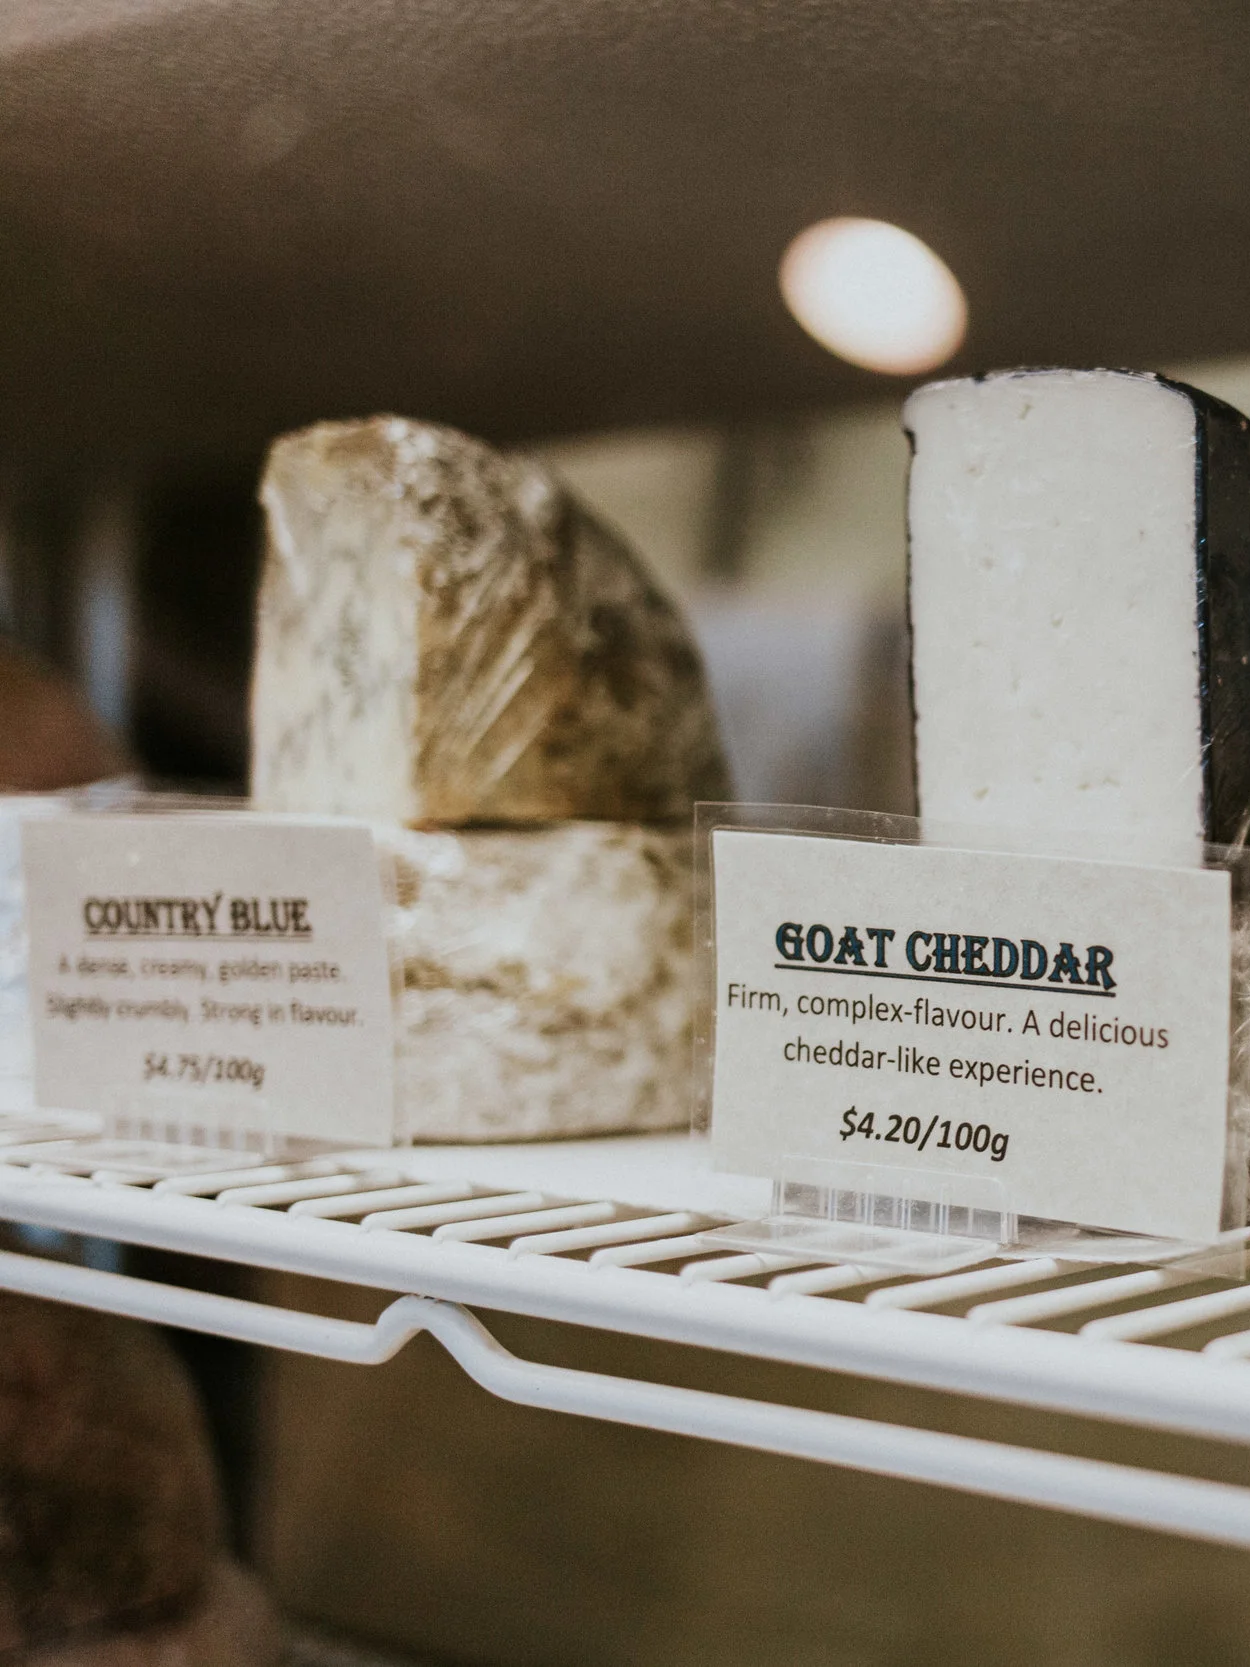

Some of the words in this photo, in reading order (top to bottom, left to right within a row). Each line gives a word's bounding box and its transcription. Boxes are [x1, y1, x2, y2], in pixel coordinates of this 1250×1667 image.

[83, 889, 223, 934] COUNTRY
[230, 895, 313, 935] BLUE
[218, 956, 284, 986] golden
[775, 922, 895, 968] GOAT
[906, 930, 1117, 990] CHEDDAR
[268, 1000, 286, 1023] in
[727, 983, 789, 1017] Firm,
[796, 990, 1013, 1036] complex-flavour.
[1022, 1009, 1041, 1036] A
[1049, 1011, 1170, 1050] delicious
[143, 1050, 267, 1090] $4.75/100g
[783, 1036, 941, 1077] cheddar-like
[949, 1057, 1103, 1095] experience.
[838, 1104, 1010, 1163] $4.20/100g
